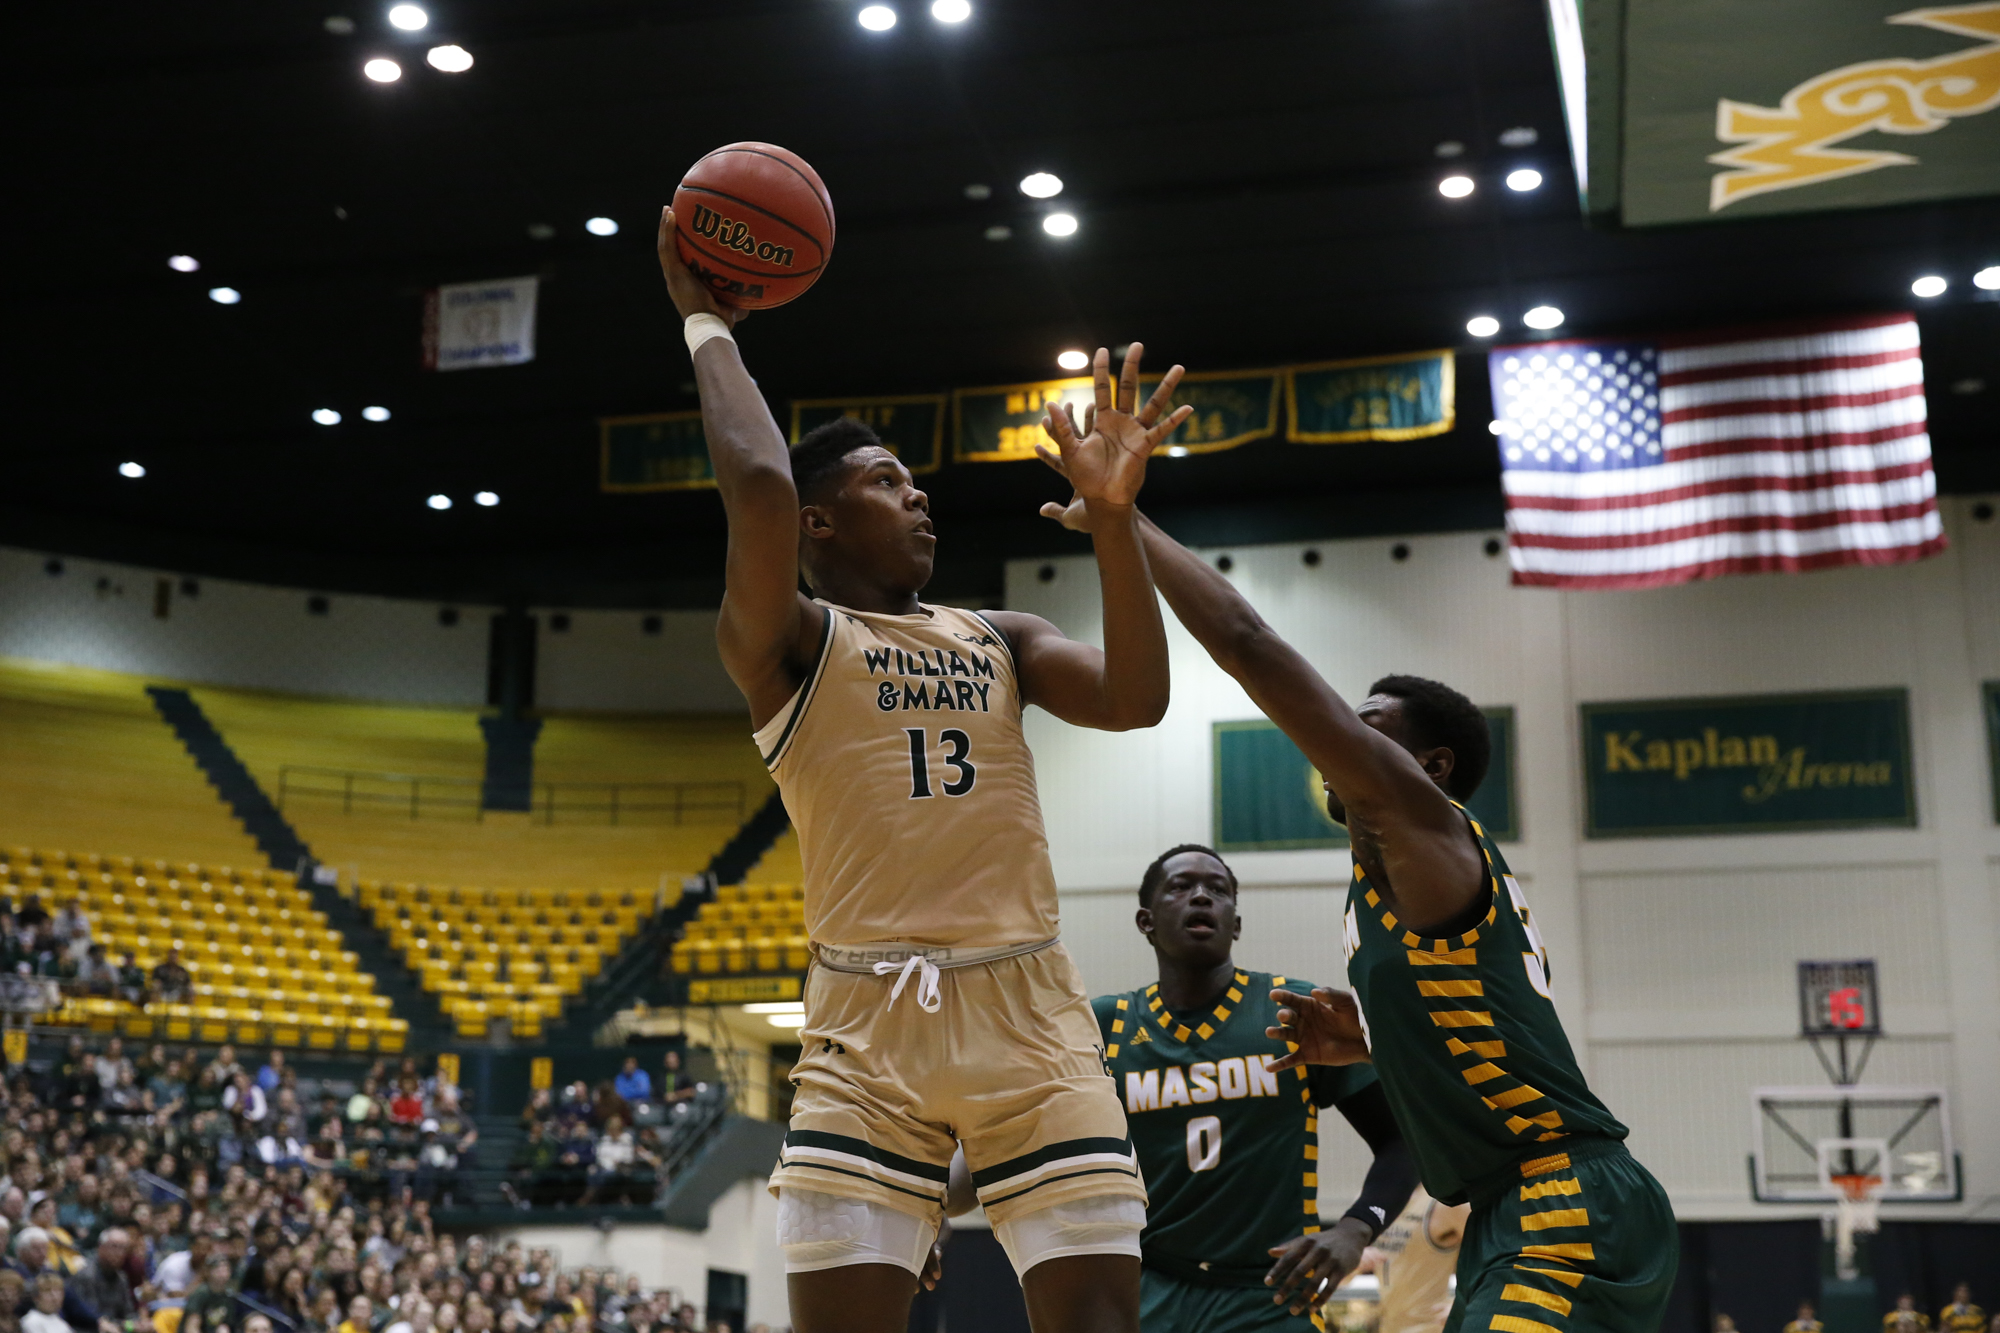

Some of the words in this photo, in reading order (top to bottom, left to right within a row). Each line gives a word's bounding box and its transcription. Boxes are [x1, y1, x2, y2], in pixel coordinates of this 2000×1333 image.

[691, 203, 795, 267] Wilson
[863, 647, 996, 680] WILLIAM
[877, 680, 990, 712] &MARY
[901, 727, 976, 800] 13
[1605, 728, 1778, 780] Kaplan
[1742, 746, 1892, 803] Arena
[1125, 1053, 1279, 1114] MASON
[1186, 1115, 1222, 1173] 0
